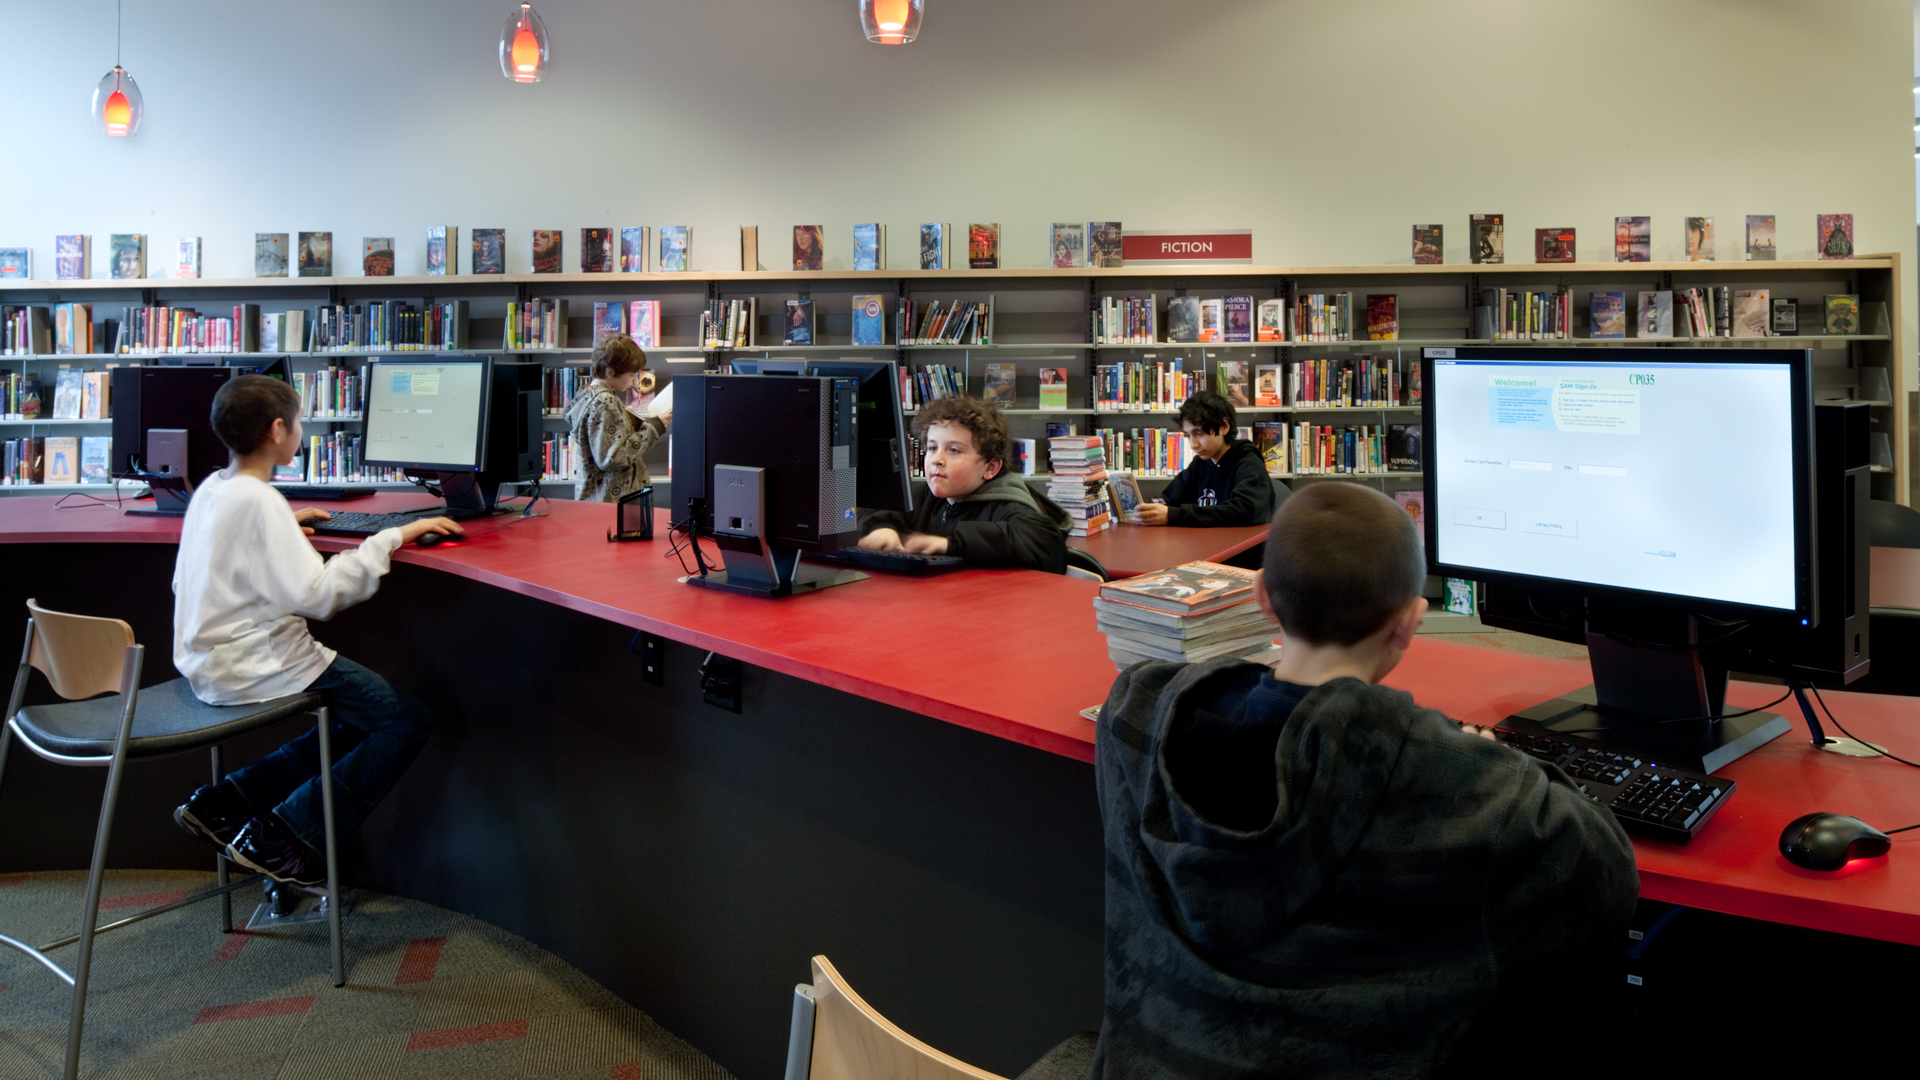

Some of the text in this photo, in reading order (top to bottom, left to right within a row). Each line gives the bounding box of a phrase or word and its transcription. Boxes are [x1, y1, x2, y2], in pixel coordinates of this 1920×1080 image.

[969, 232, 998, 241] PURPLE
[970, 241, 993, 250] HEART
[1161, 241, 1213, 253] FICTION
[923, 245, 941, 262] FIGHT
[1494, 378, 1537, 387] Welcome!
[1629, 373, 1655, 386] CP035
